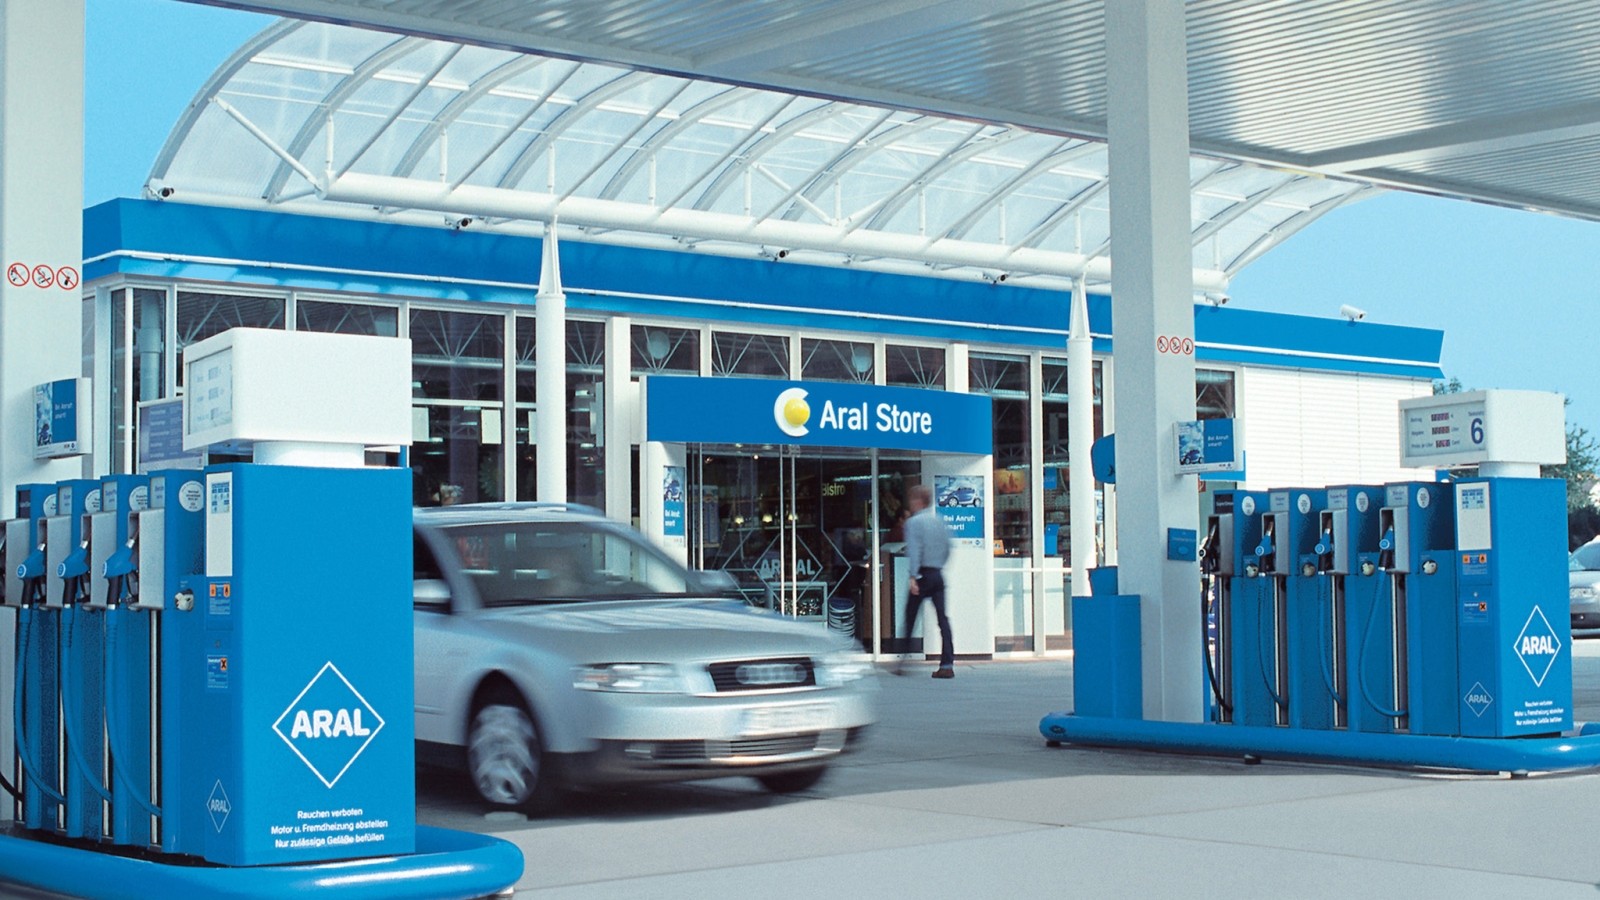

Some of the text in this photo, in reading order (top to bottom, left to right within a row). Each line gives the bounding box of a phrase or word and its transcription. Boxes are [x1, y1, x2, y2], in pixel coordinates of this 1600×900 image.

[819, 400, 932, 435] Aral Store
[1470, 417, 1484, 445] 6
[822, 483, 846, 496] Bistro
[1521, 635, 1556, 655] ARAL
[1468, 694, 1489, 704] ARAL
[290, 708, 371, 739] ARAL
[210, 799, 228, 813] ARAL
[297, 808, 363, 819] Rauchen verboten
[271, 825, 293, 835] Motor
[302, 821, 354, 832] Fremdheizung
[355, 819, 388, 829] abstellen
[275, 839, 289, 848] Nur
